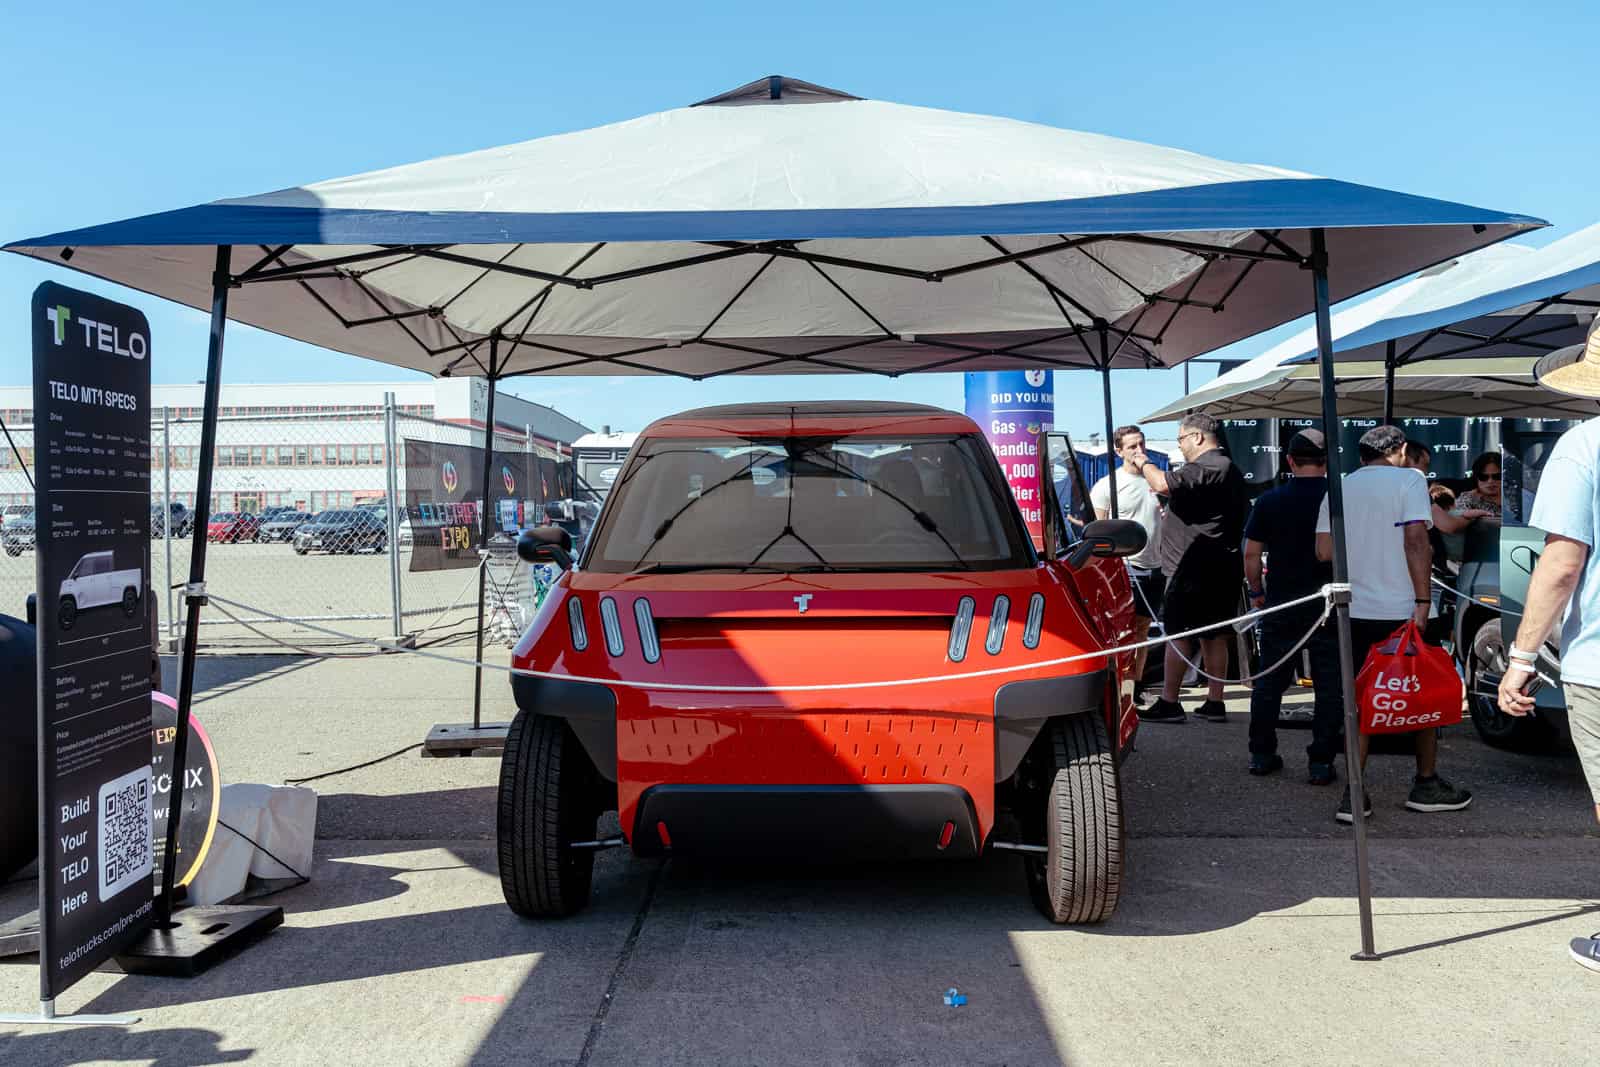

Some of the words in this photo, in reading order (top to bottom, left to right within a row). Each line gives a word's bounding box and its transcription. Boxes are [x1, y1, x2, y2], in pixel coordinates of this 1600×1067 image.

[78, 316, 147, 360] TELO
[48, 380, 79, 402] TELO
[81, 386, 103, 405] MT1
[105, 390, 137, 411] SPECS
[991, 392, 1012, 404] DID
[1016, 392, 1039, 403] YOU
[991, 419, 1017, 435] Gas
[991, 441, 1038, 457] handle
[1000, 463, 1036, 481] 1,000
[440, 526, 470, 550] EXPO
[1374, 671, 1421, 693] Let's
[1372, 692, 1408, 712] Go
[1370, 711, 1442, 728] Places
[156, 726, 177, 745] EXP
[61, 795, 91, 824] Build
[61, 829, 88, 854] Your
[61, 856, 89, 885] TELO
[61, 890, 88, 917] Here
[59, 900, 153, 970] telotrucks.com/pre-order
